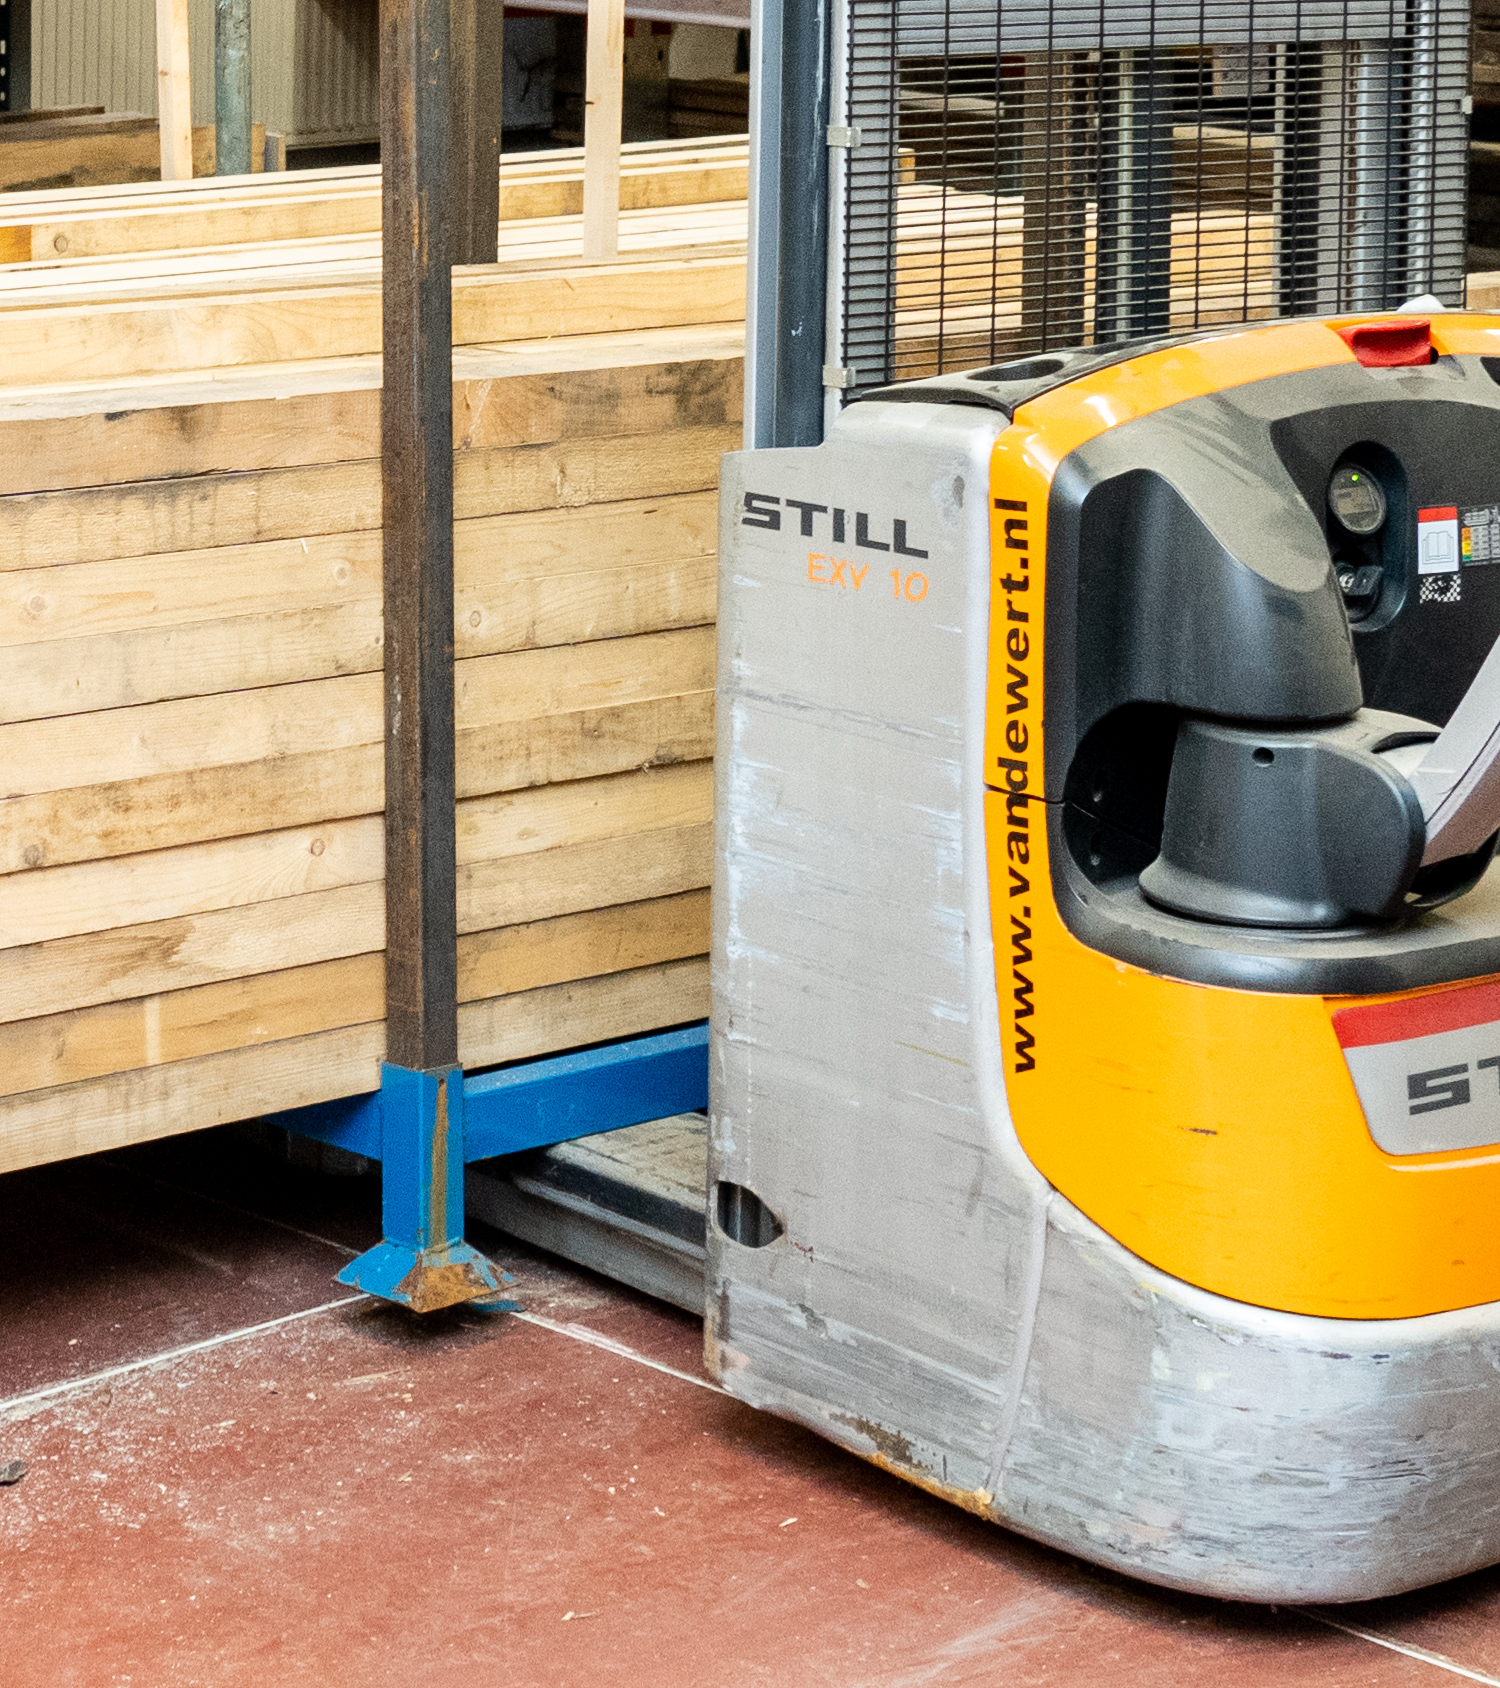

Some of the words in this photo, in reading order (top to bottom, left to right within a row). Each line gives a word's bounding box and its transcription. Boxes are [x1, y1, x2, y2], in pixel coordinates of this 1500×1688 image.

[741, 491, 930, 560] STILL
[807, 551, 871, 592] EXV
[889, 567, 930, 603] 10
[994, 498, 1036, 1074] www.vandewert.nl
